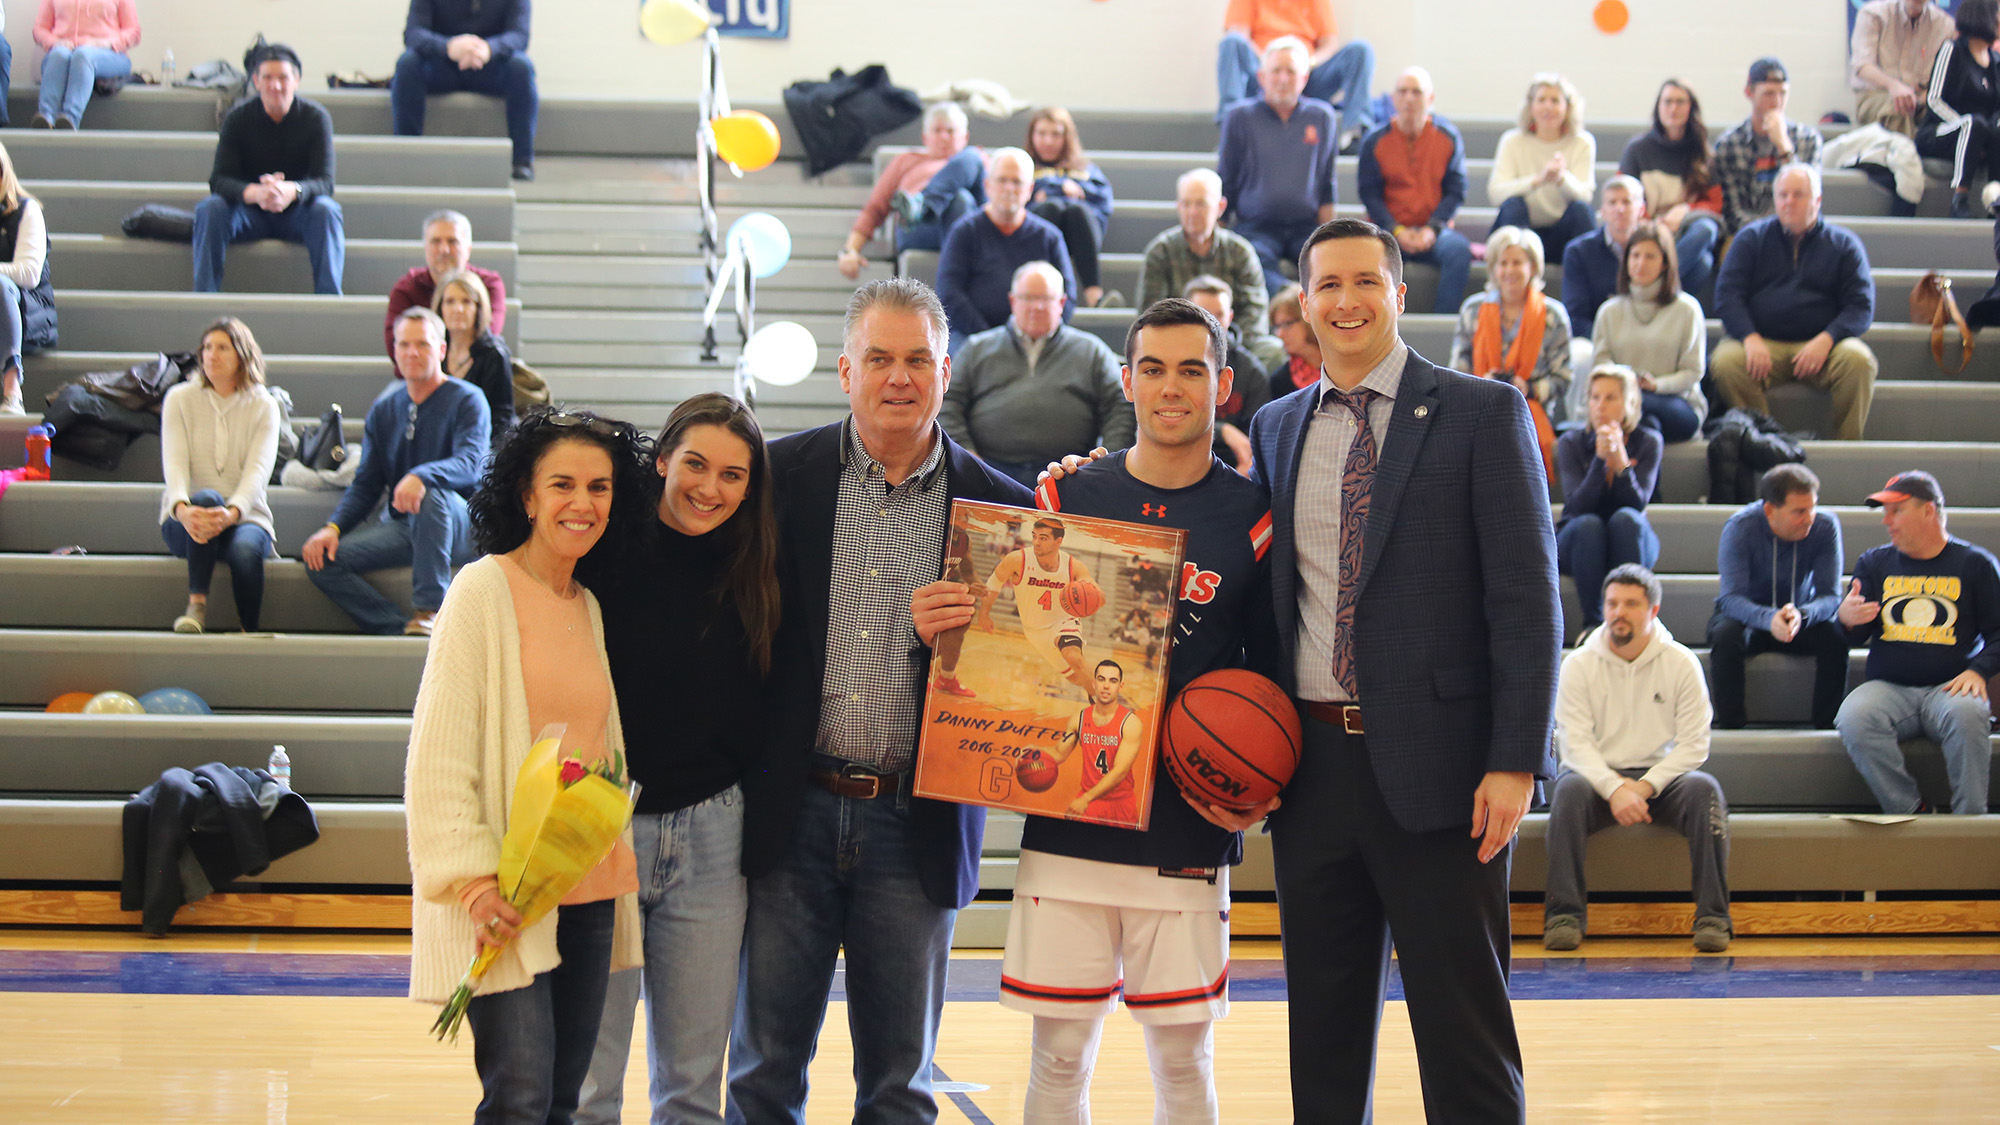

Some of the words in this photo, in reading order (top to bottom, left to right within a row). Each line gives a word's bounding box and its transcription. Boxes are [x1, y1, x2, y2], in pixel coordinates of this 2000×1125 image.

[1027, 577, 1066, 589] Bullets
[1038, 590, 1052, 611] 4
[933, 711, 994, 732] DANNY
[994, 719, 1074, 743] DUFFEY
[1083, 733, 1119, 746] GETTYSBURG
[1095, 749, 1109, 775] 4
[1186, 747, 1250, 798] NCAA
[979, 756, 1014, 802] G
